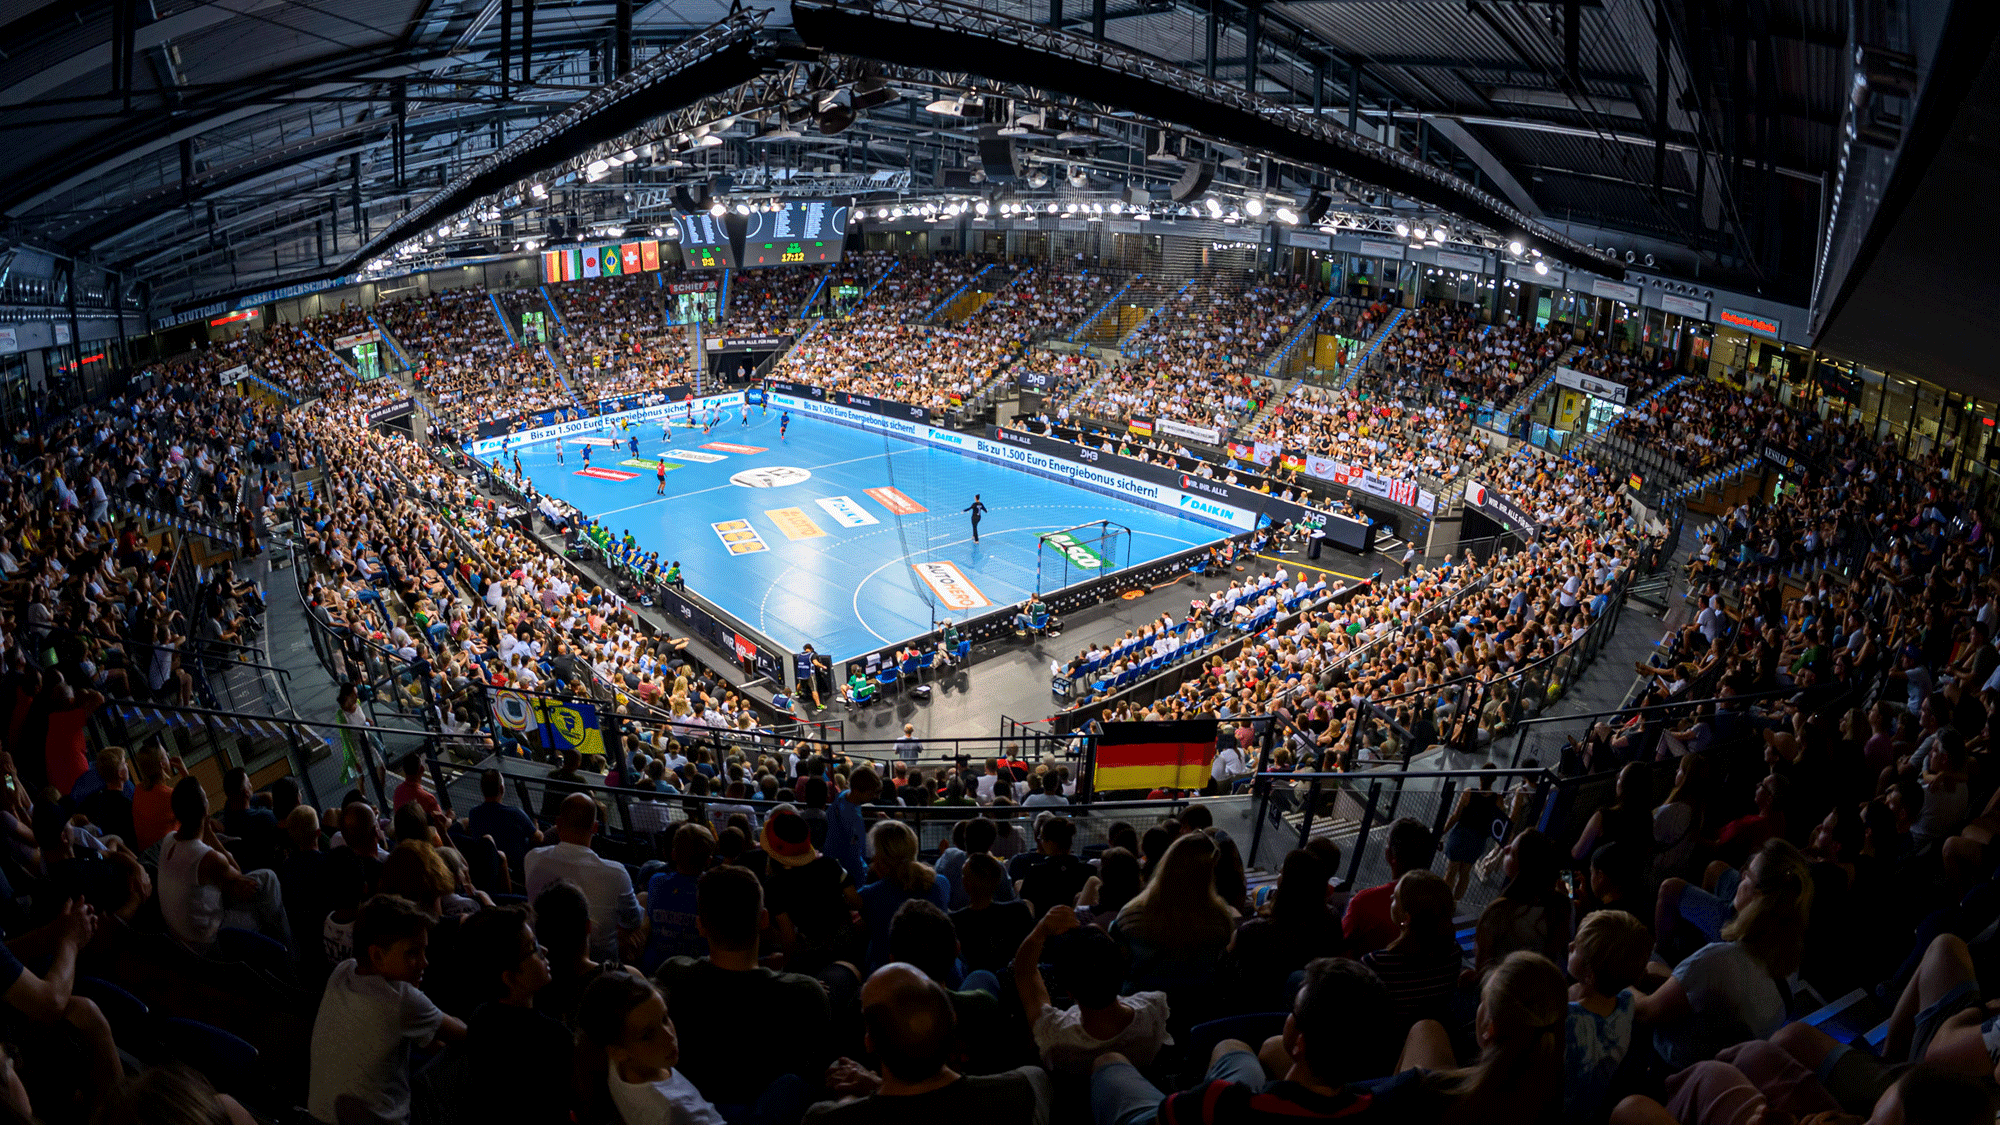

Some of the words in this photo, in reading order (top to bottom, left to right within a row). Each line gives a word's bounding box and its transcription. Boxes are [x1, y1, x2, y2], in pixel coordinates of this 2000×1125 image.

[781, 253, 805, 262] 17:12
[177, 301, 227, 325] STUTTGART
[820, 403, 835, 416] 1.500
[835, 407, 847, 418] Euro
[849, 411, 889, 428] Energiebonus
[890, 419, 916, 434] sichern!
[531, 431, 544, 440] Bis
[558, 422, 582, 434] 1.500
[935, 432, 962, 444] DAIKIN
[977, 440, 990, 452] Bis
[991, 445, 1000, 455] zu
[1002, 446, 1025, 462] 1.500
[1027, 452, 1047, 467] Euro
[1049, 458, 1115, 487] Energiebonus
[1117, 476, 1158, 499] sichern!
[1191, 500, 1235, 520] DAIKIN
[926, 564, 975, 606] AUTOHERO
